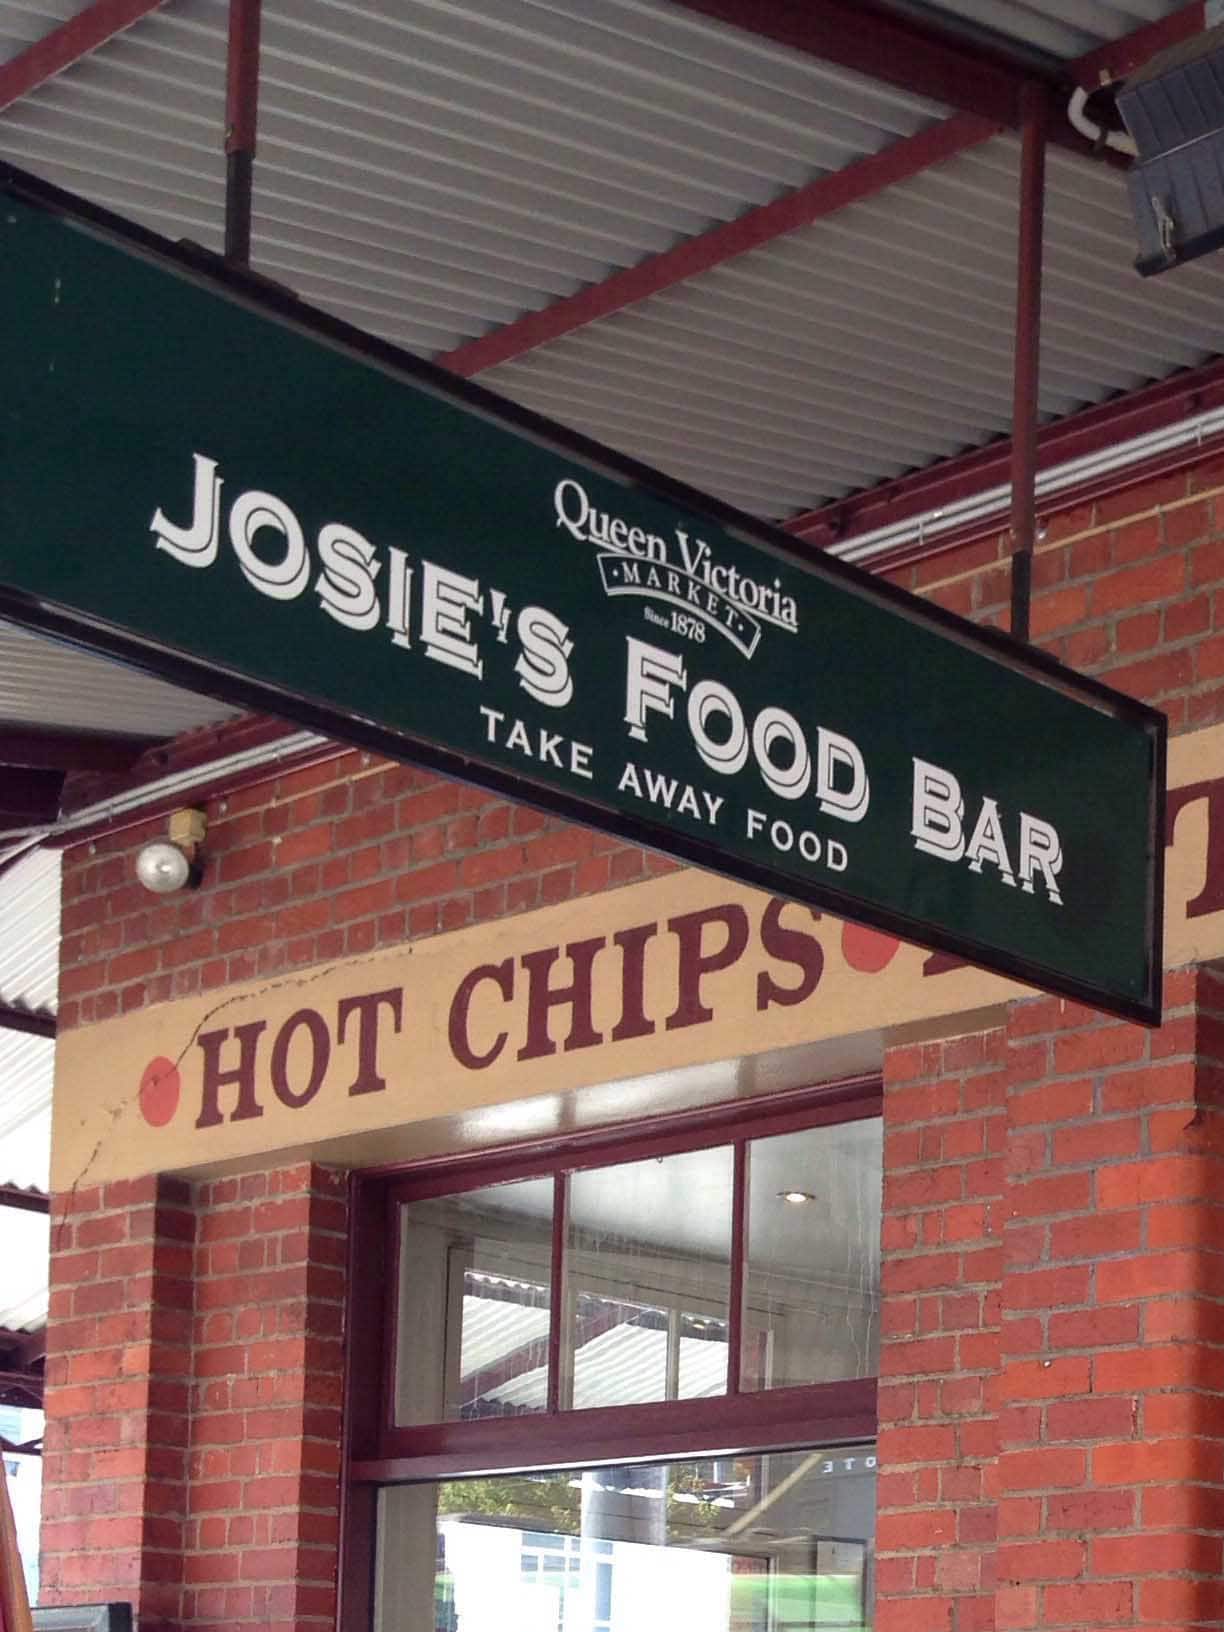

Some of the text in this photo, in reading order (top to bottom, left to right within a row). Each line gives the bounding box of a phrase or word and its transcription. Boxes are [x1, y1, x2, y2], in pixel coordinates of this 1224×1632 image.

[554, 479, 799, 627] Queen Victoria
[620, 561, 740, 627] MARKET
[643, 606, 706, 643] Since 1878
[149, 452, 575, 708] JOSIE'S
[624, 636, 870, 823] FOOD
[910, 757, 1064, 905] BAR
[480, 705, 848, 872] TAKE AWAY FOOD
[195, 900, 827, 1129] HOT CHIPS
